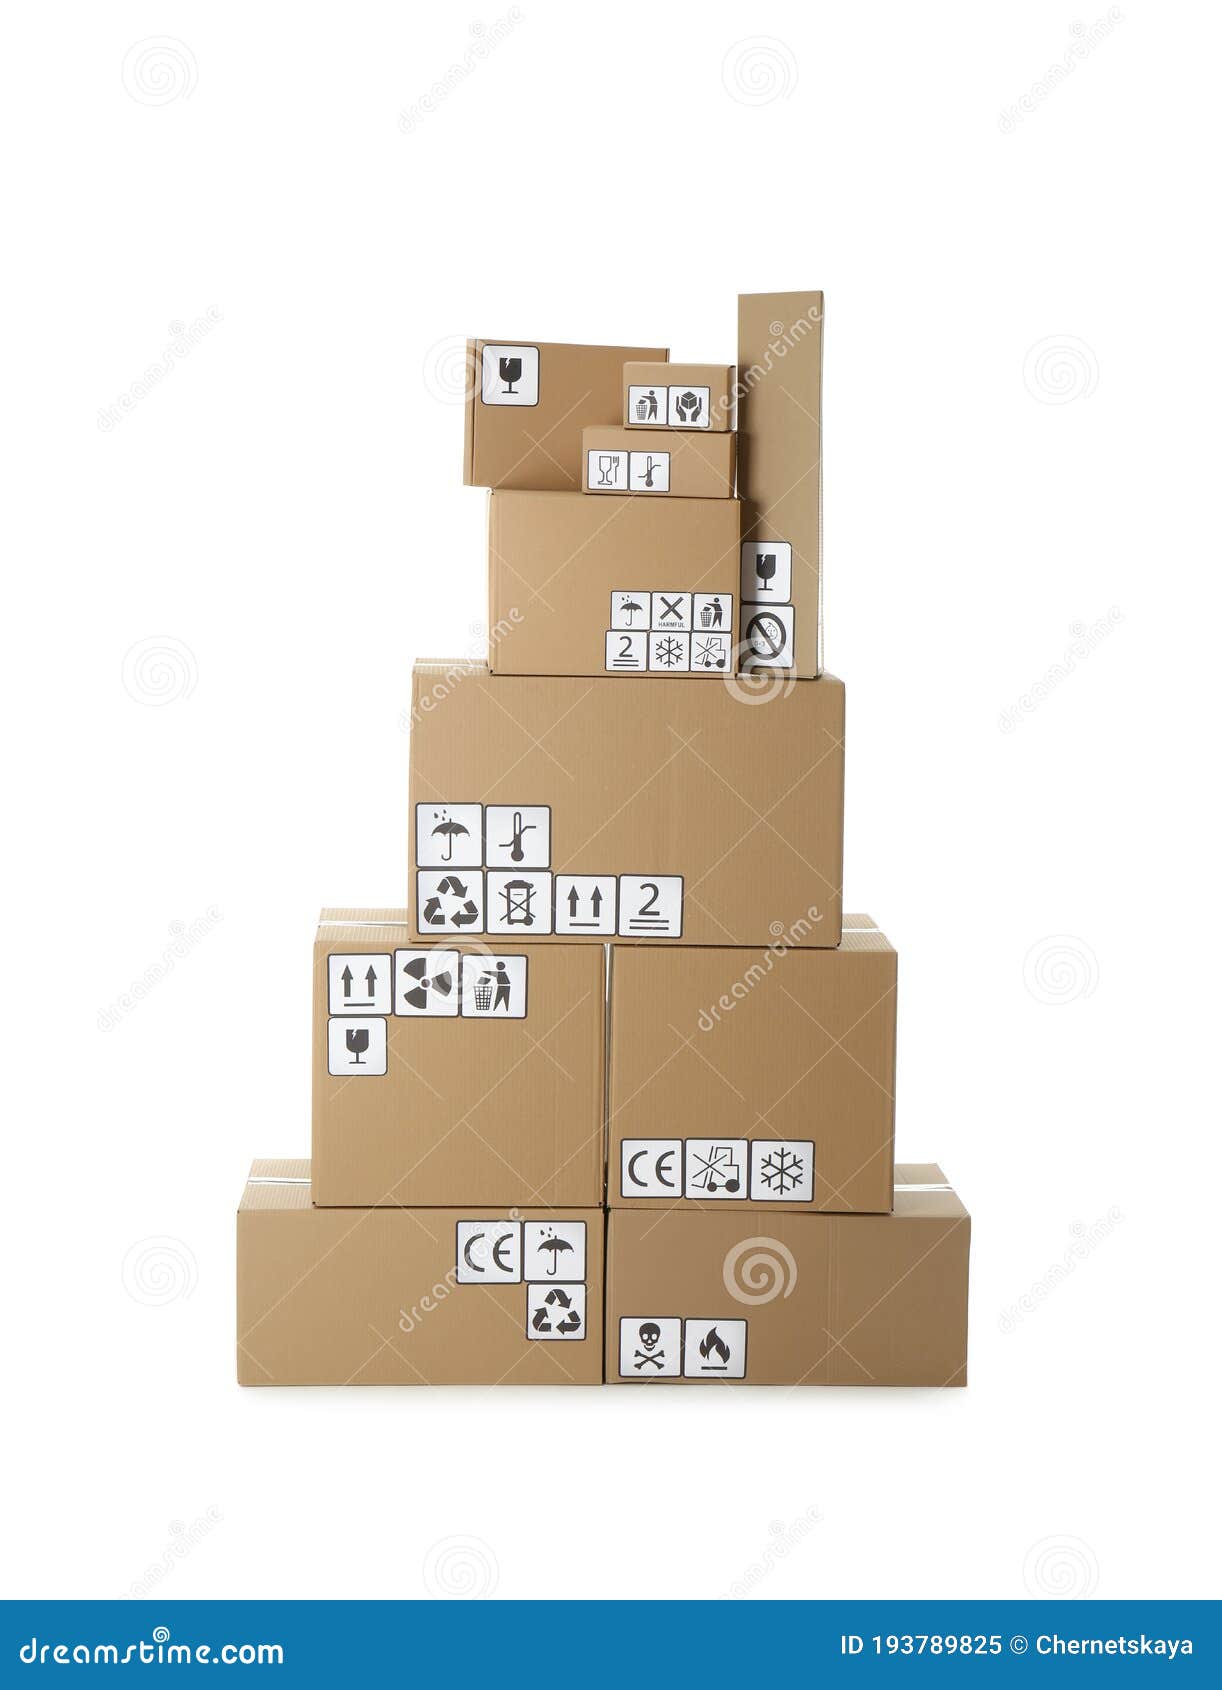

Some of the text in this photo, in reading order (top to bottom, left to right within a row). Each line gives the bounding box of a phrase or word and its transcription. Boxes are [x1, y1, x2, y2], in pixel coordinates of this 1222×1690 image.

[618, 635, 633, 658] 2
[638, 882, 661, 916] 2
[628, 1150, 675, 1188] CE
[463, 1232, 514, 1273] CE
